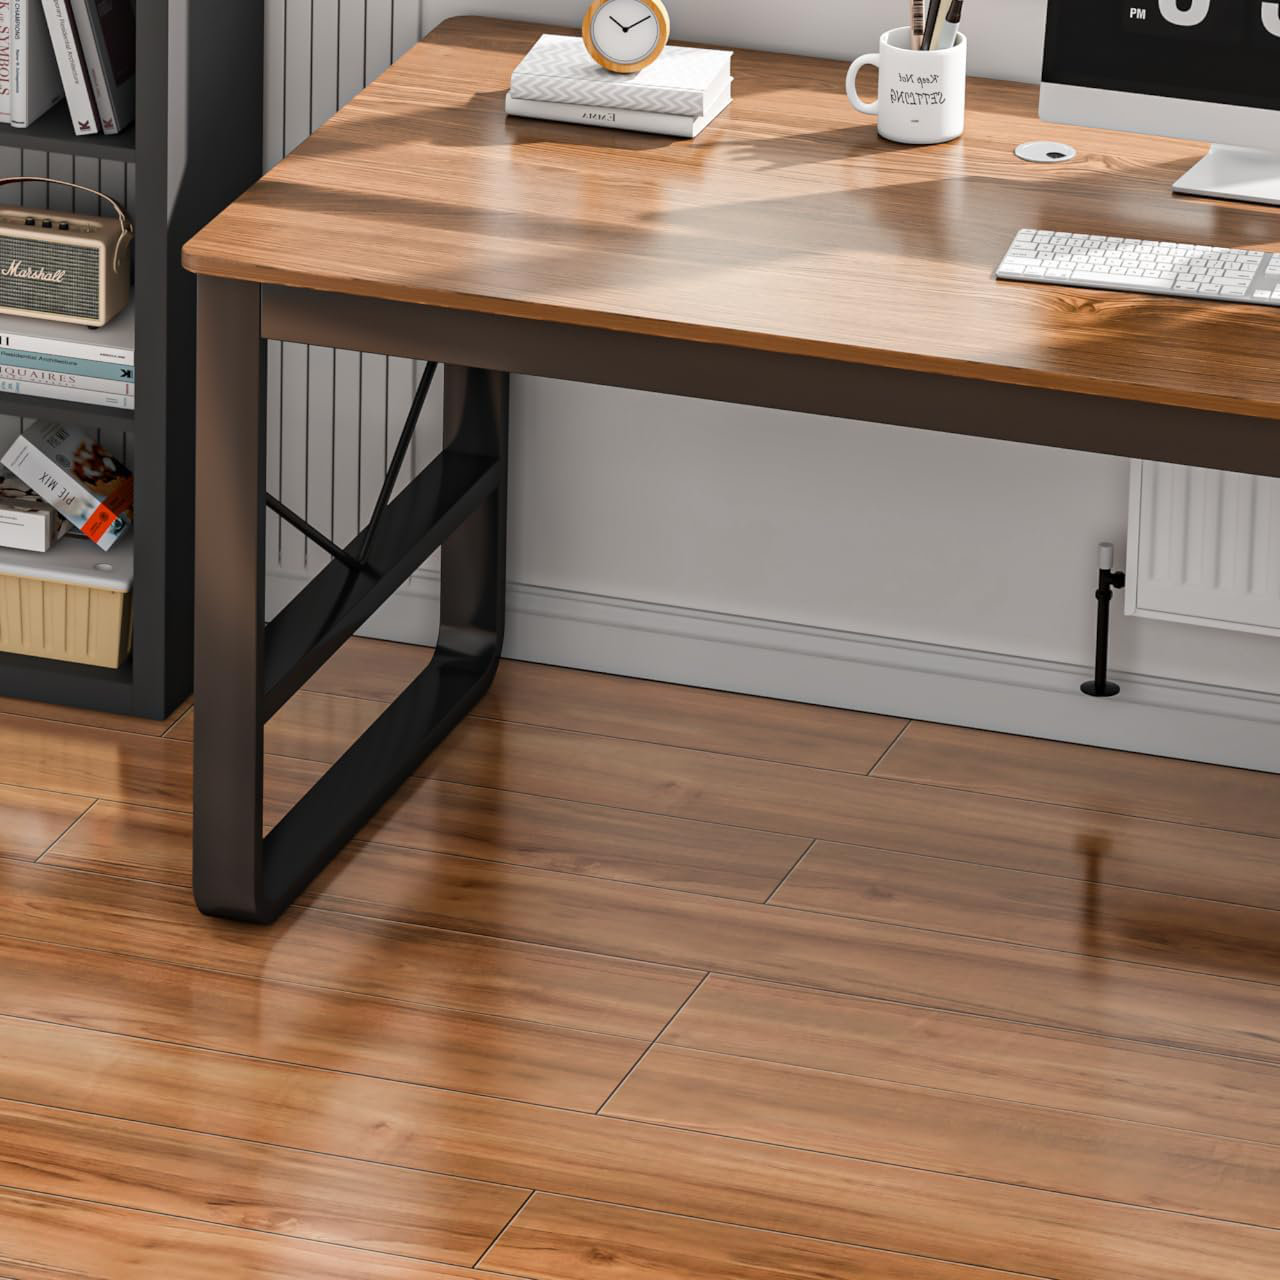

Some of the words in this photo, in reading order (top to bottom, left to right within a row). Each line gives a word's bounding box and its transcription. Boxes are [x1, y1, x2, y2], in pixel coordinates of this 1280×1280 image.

[1129, 7, 1146, 20] PM
[0, 25, 10, 95] SYMBOLS
[58, 19, 72, 50] Residential
[67, 51, 80, 85] Architecture
[1, 259, 66, 283] Marshall
[1, 350, 38, 361] Residential
[38, 356, 78, 366] Architecture
[38, 471, 58, 491] MIX
[58, 488, 75, 505] PIE
